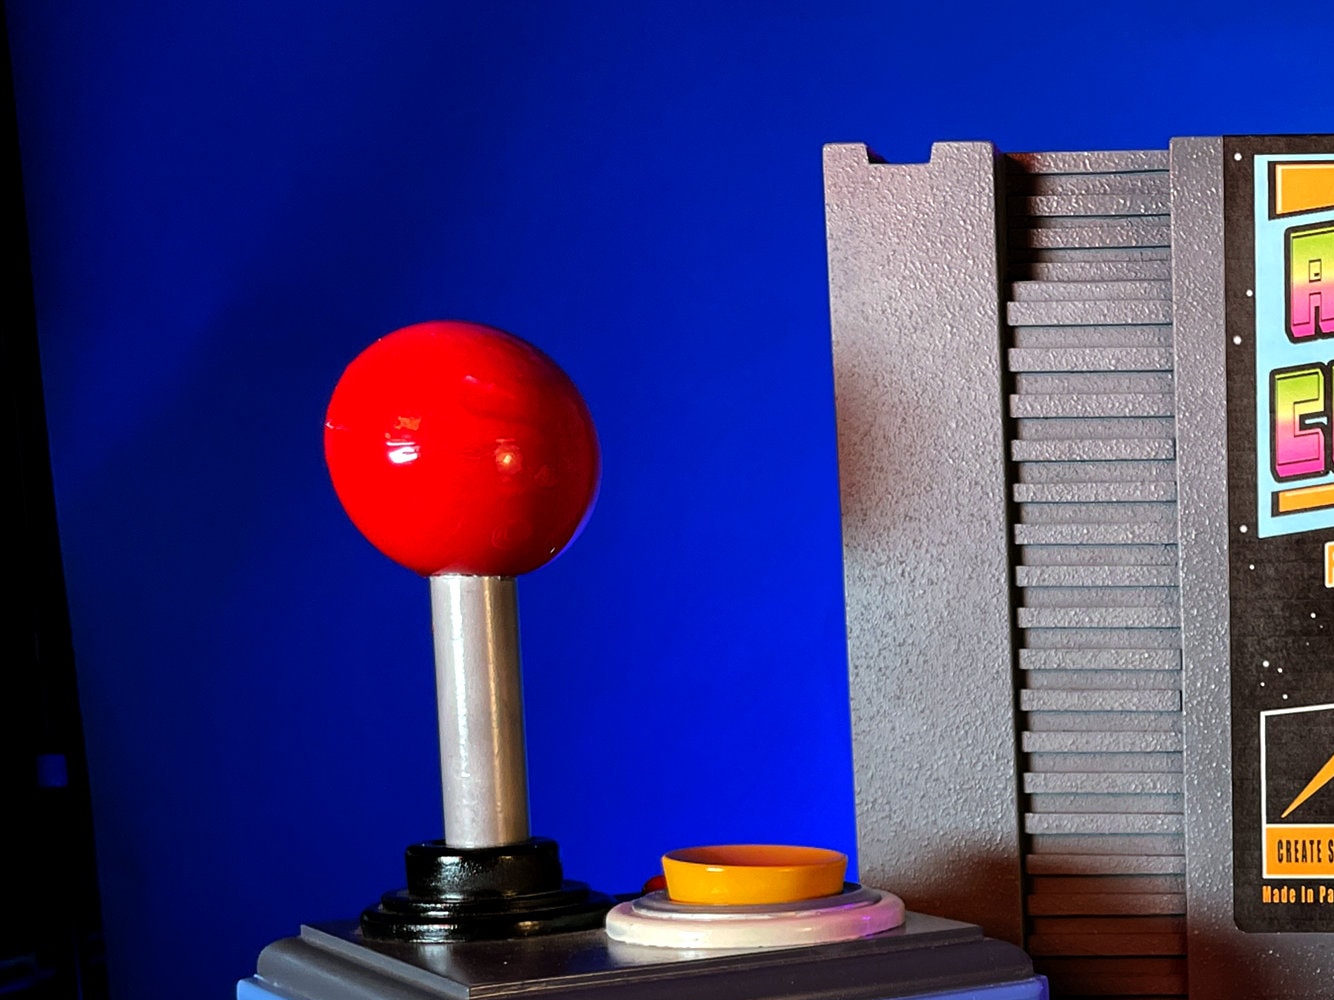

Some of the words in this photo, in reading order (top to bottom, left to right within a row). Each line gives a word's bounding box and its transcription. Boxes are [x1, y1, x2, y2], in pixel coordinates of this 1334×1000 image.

[1277, 839, 1322, 863] CREATE
[1262, 885, 1296, 903] Made
[1301, 885, 1314, 903] In
